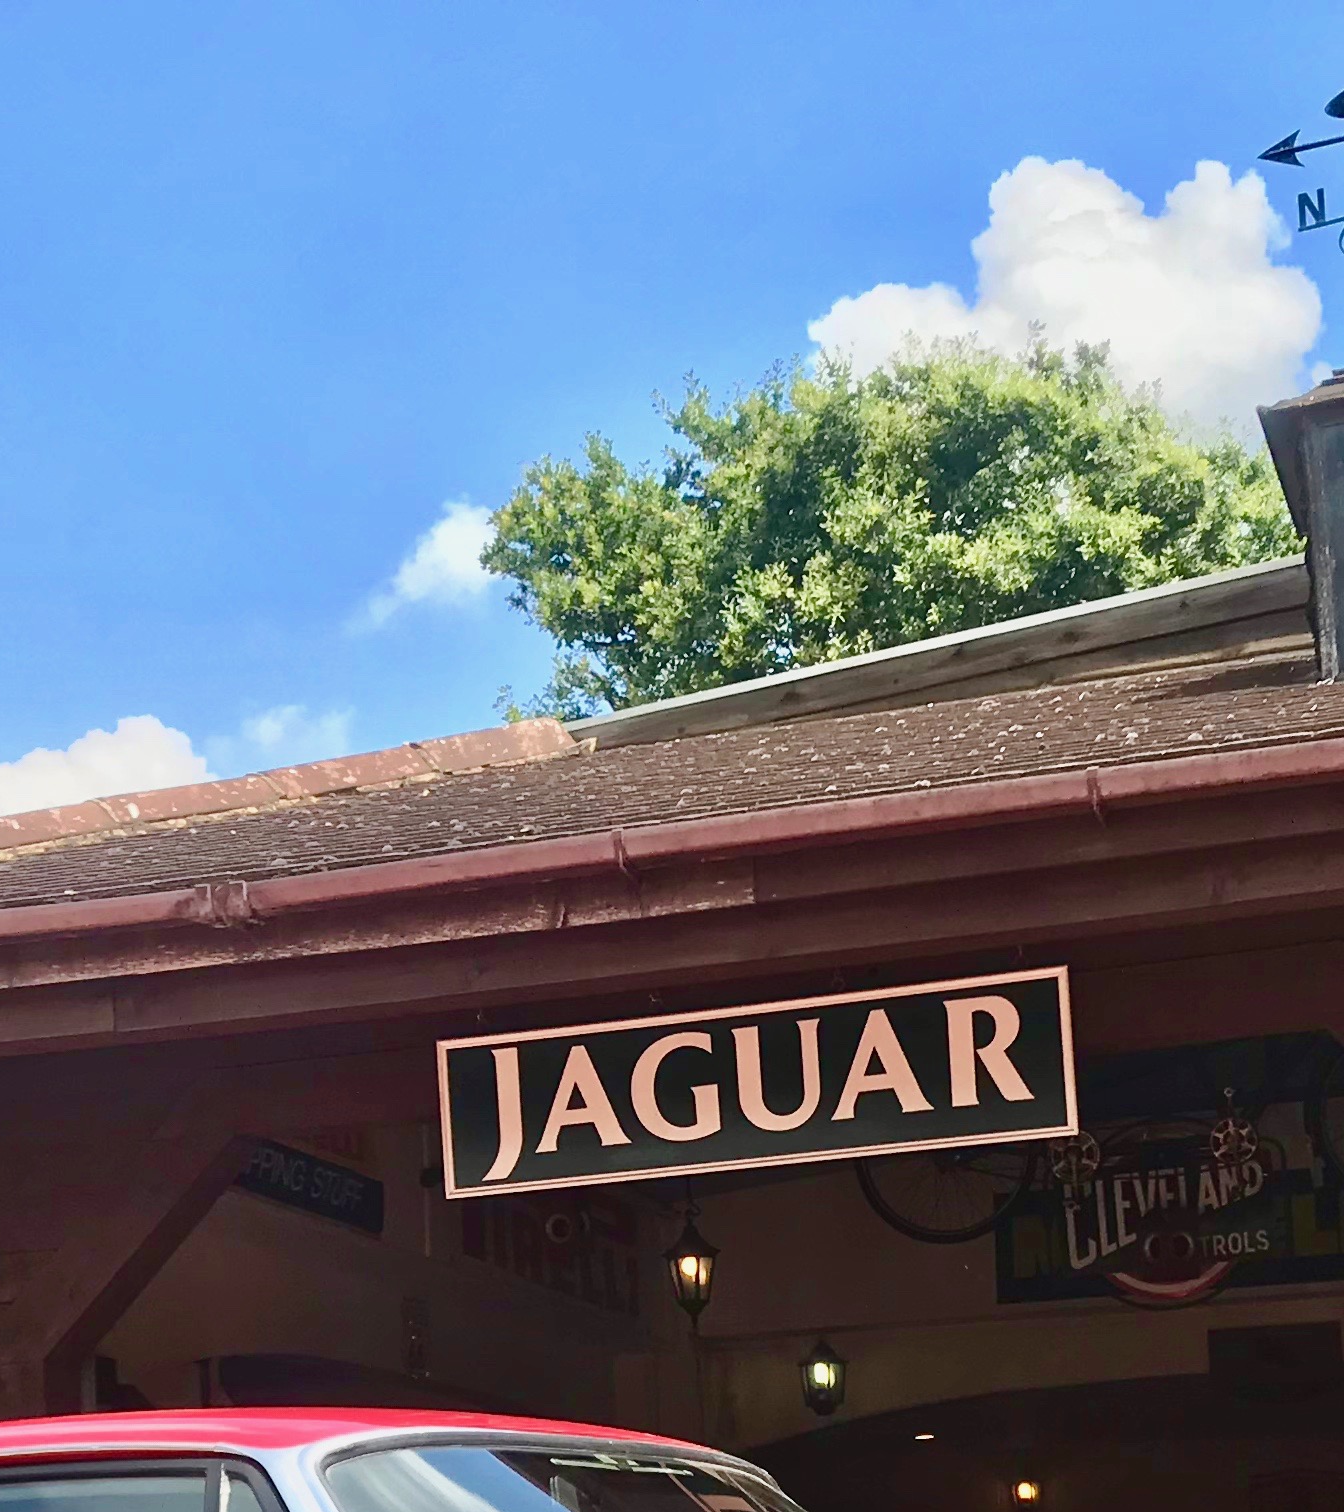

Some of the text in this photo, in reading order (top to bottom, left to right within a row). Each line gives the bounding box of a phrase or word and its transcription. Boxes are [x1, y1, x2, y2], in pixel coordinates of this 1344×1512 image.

[1297, 188, 1326, 229] N
[481, 994, 1036, 1182] JAGUAR
[1199, 1229, 1270, 1257] TROLS
